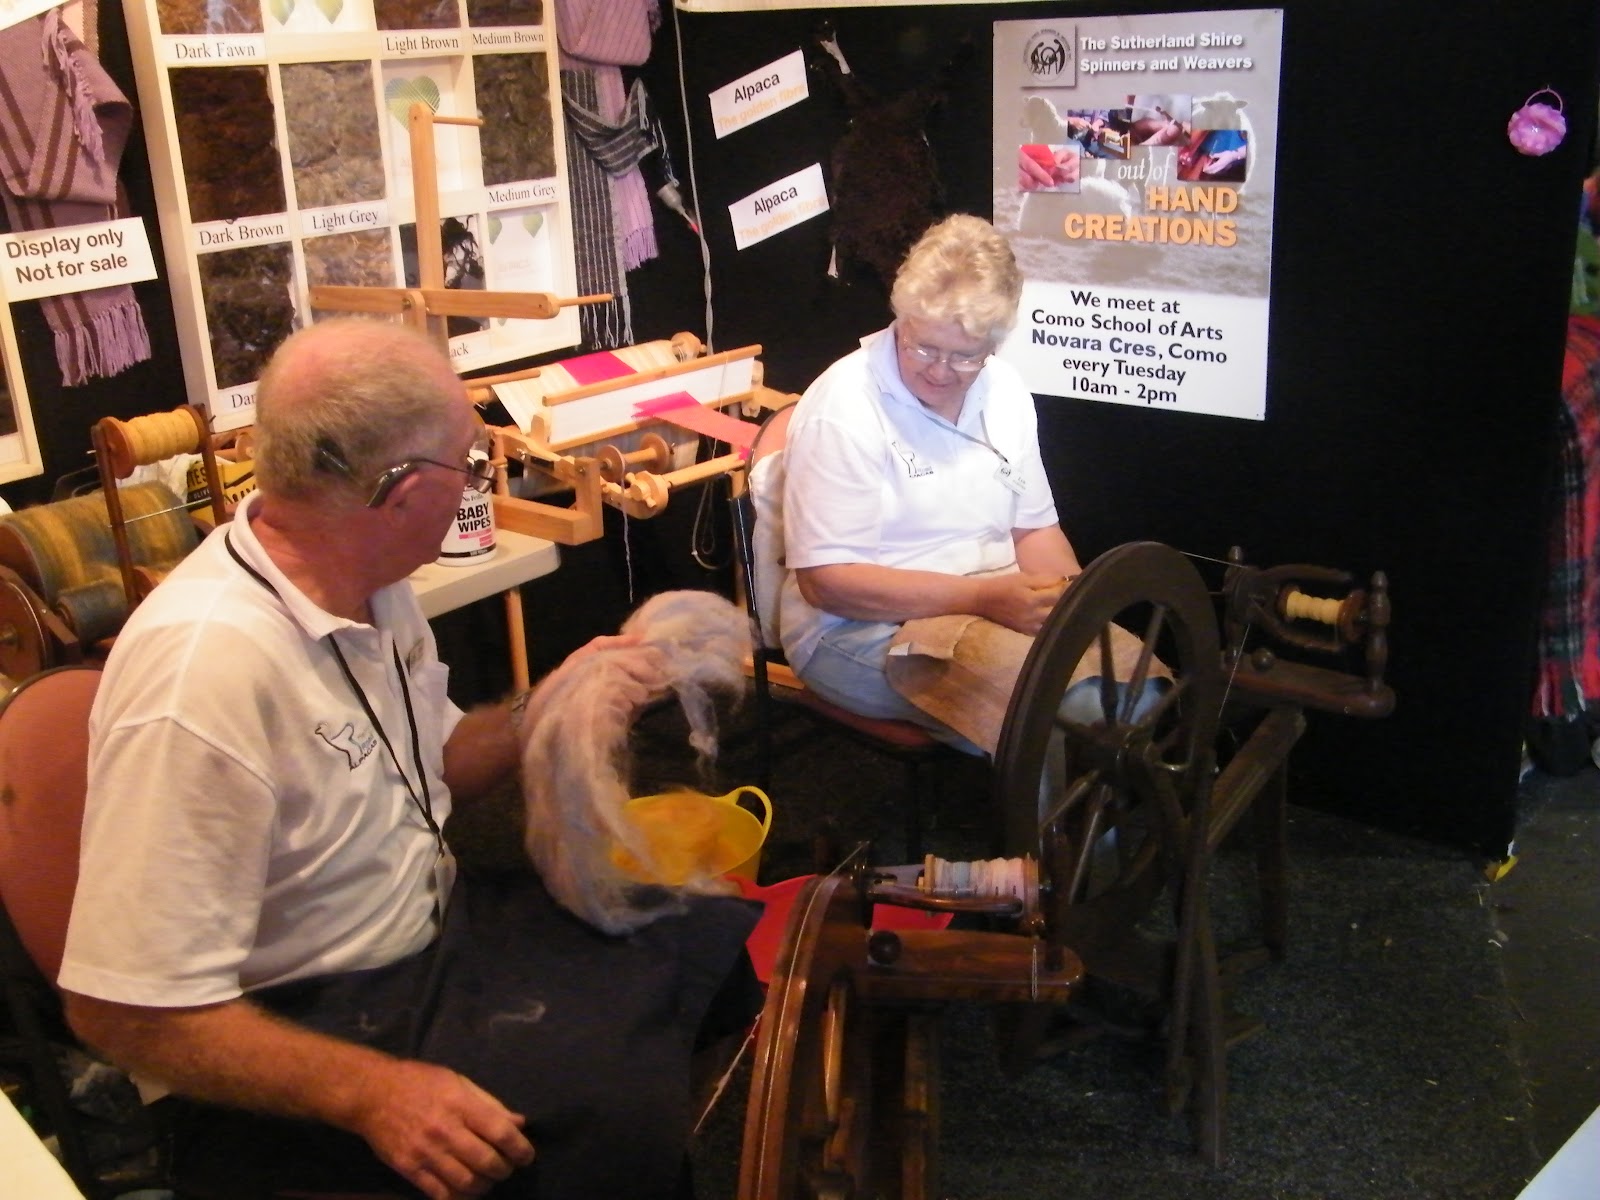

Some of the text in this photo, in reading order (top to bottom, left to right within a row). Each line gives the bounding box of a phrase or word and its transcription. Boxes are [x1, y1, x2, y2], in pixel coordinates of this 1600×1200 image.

[175, 42, 256, 59] Dark Fawn
[386, 36, 459, 54] Light Brown
[472, 31, 544, 46] Medium Brown
[1079, 36, 1106, 51] The
[1110, 33, 1195, 50] Sutherland
[1199, 32, 1243, 47] Shire
[1079, 54, 1253, 74] Spinners and Weavers
[734, 73, 781, 104] Alpaca
[1117, 153, 1175, 186] out of
[489, 184, 557, 204] Medium Grey
[754, 186, 799, 215] Alpaca
[1150, 186, 1238, 213] HAND
[312, 210, 379, 232] Light Grey
[1064, 212, 1238, 248] CREATIONS
[6, 228, 124, 258] Display only
[200, 223, 284, 247] Dark Brown
[15, 253, 128, 284] Not for sale
[1070, 290, 1181, 314] We meet at
[1031, 309, 1223, 341] Como School of Arts
[1031, 328, 1228, 364] Novara Cres, Como
[1062, 358, 1187, 386] every Tuesday
[231, 393, 257, 409] Dar
[1072, 376, 1118, 396] 10am
[1137, 383, 1177, 404] 2pm
[456, 502, 489, 521] BABY
[457, 516, 491, 533] WIPES
